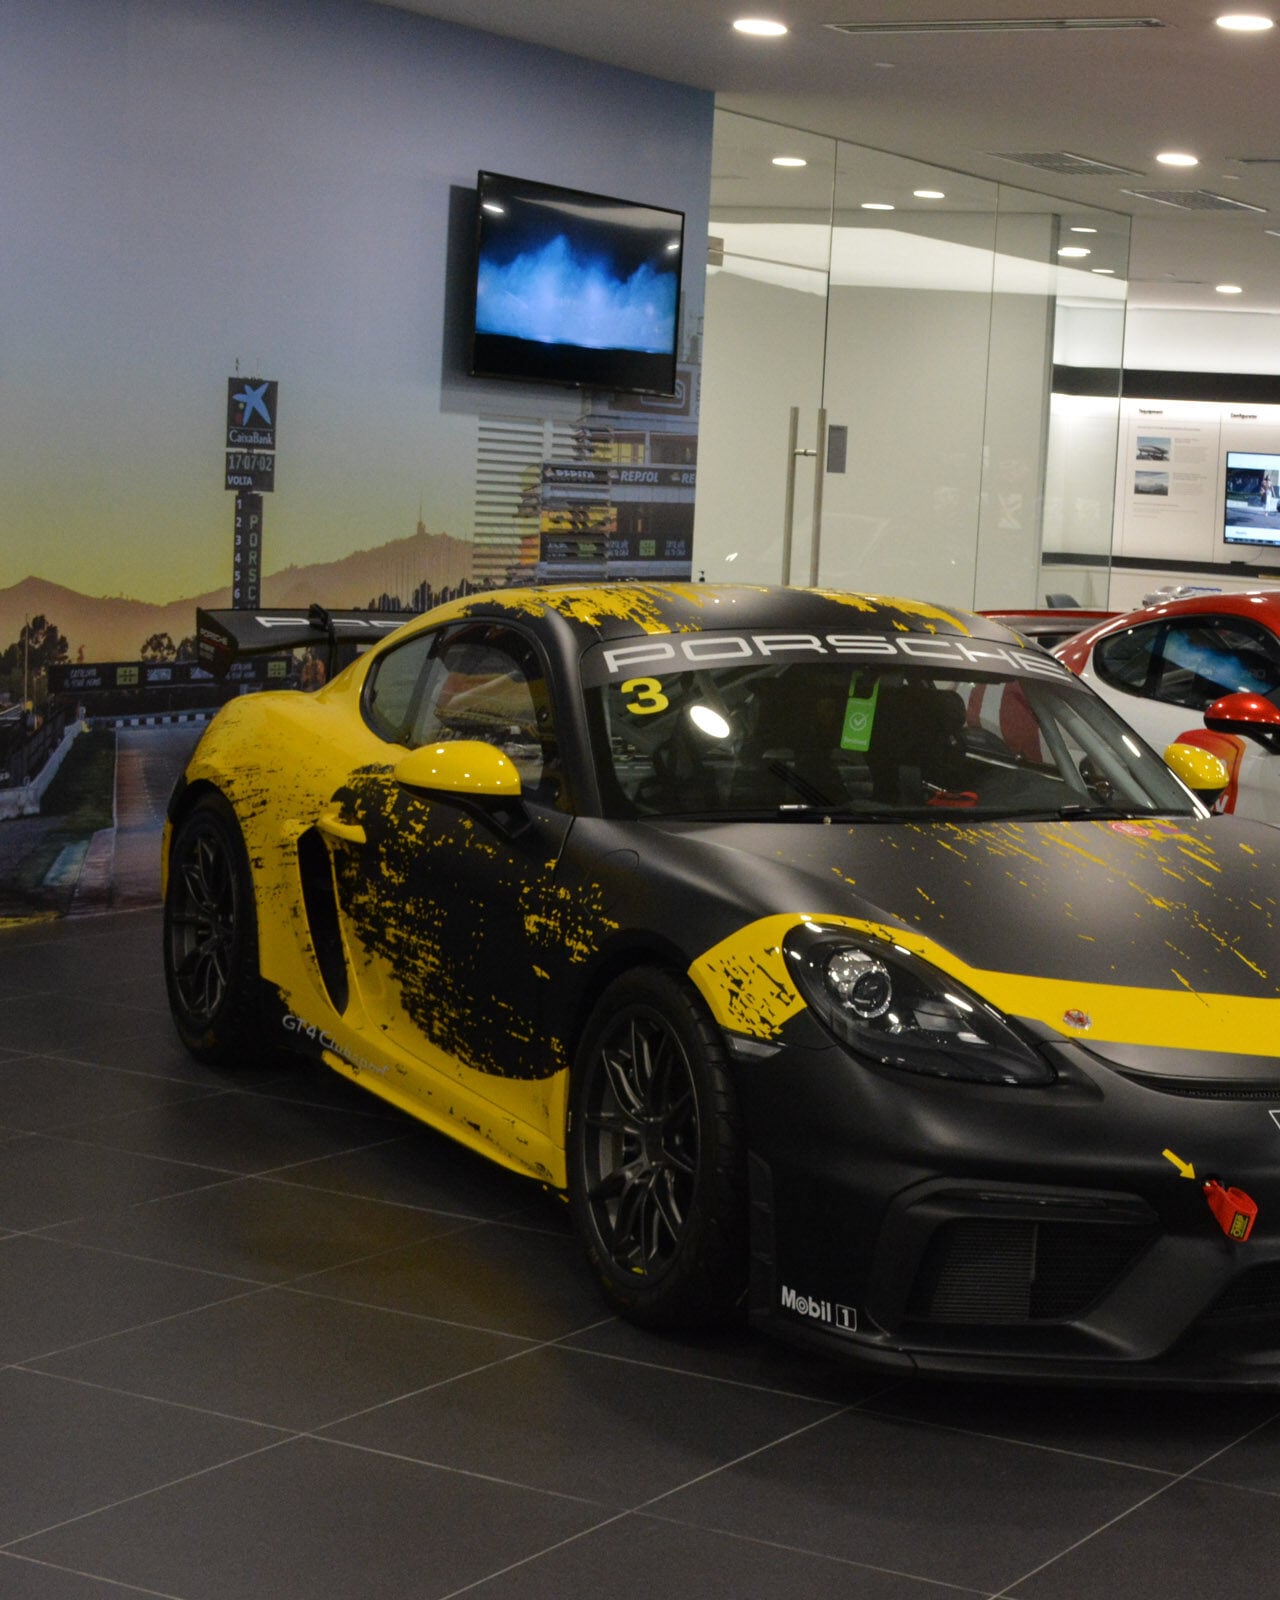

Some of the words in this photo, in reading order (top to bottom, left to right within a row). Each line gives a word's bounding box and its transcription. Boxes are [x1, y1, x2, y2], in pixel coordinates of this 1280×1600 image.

[229, 429, 272, 445] CaixaBank
[227, 475, 252, 485] VOLTA
[620, 471, 659, 482] REPSOL
[602, 634, 1073, 683] PORSCHE
[621, 677, 669, 714] 3
[319, 1029, 390, 1076] Clubsport
[781, 1284, 831, 1322] Mobil
